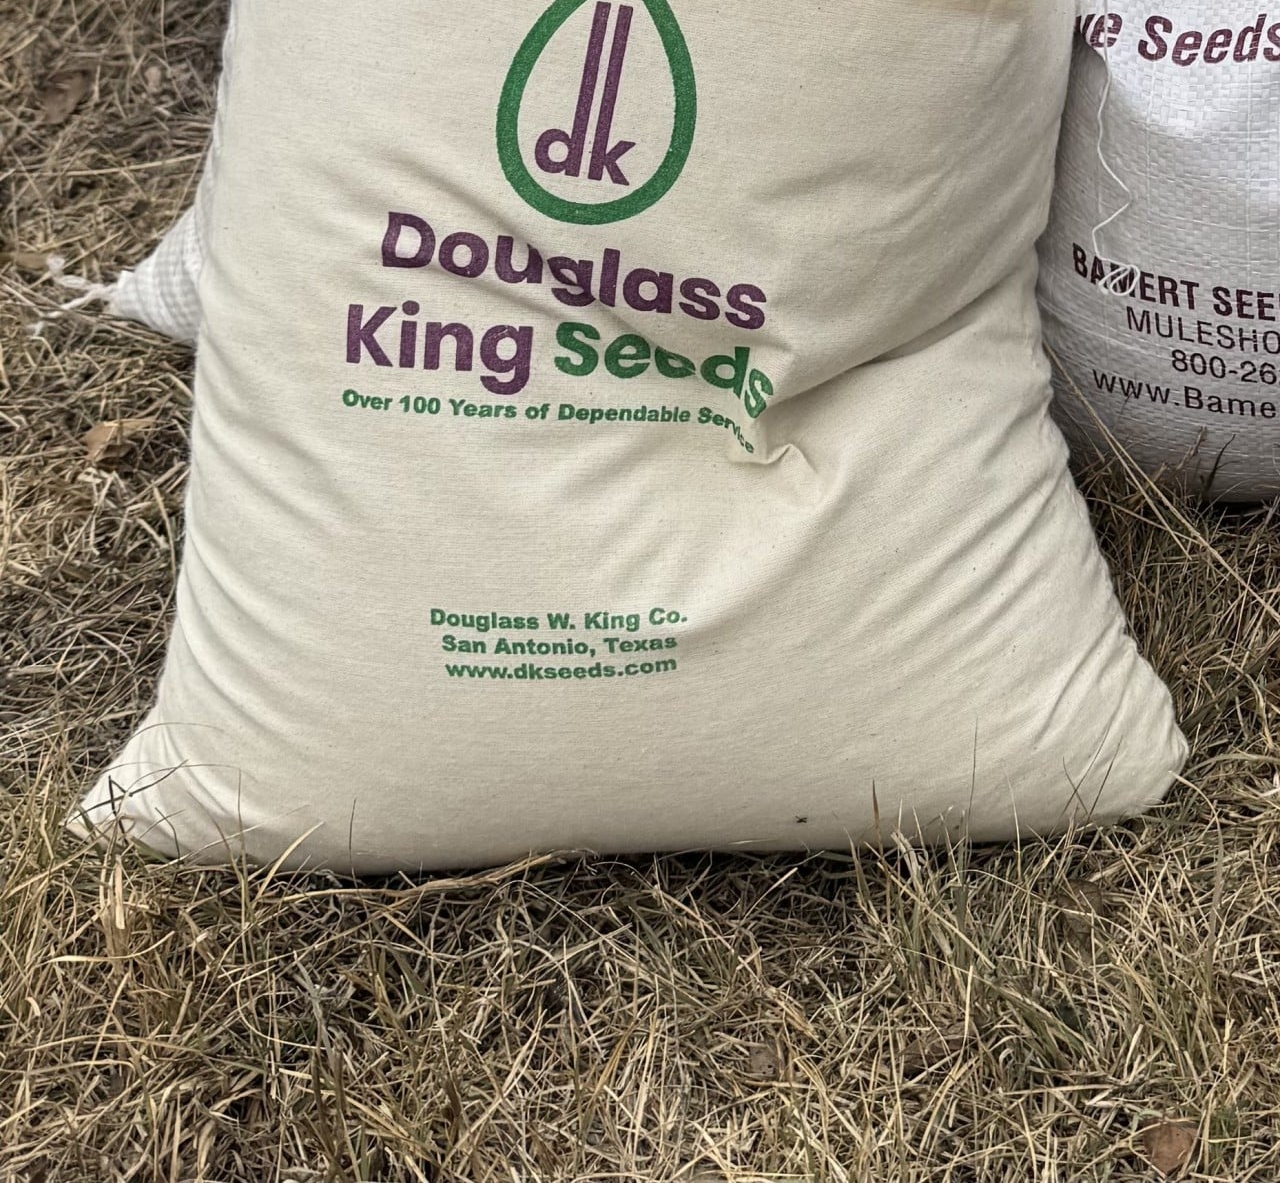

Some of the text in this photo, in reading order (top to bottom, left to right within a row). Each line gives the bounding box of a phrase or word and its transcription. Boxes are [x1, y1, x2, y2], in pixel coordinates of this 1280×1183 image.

[533, 0, 636, 186] dk
[382, 211, 767, 330] Douglass
[1072, 242, 1200, 310] BAMERT
[345, 300, 774, 418] King Seeds
[342, 388, 755, 454] Over 100 Years of Dependable Service
[430, 607, 688, 632] Douglass W. King Co.
[442, 634, 678, 657] San Antonio, Texas
[445, 657, 677, 680] www.dkseeds.com
